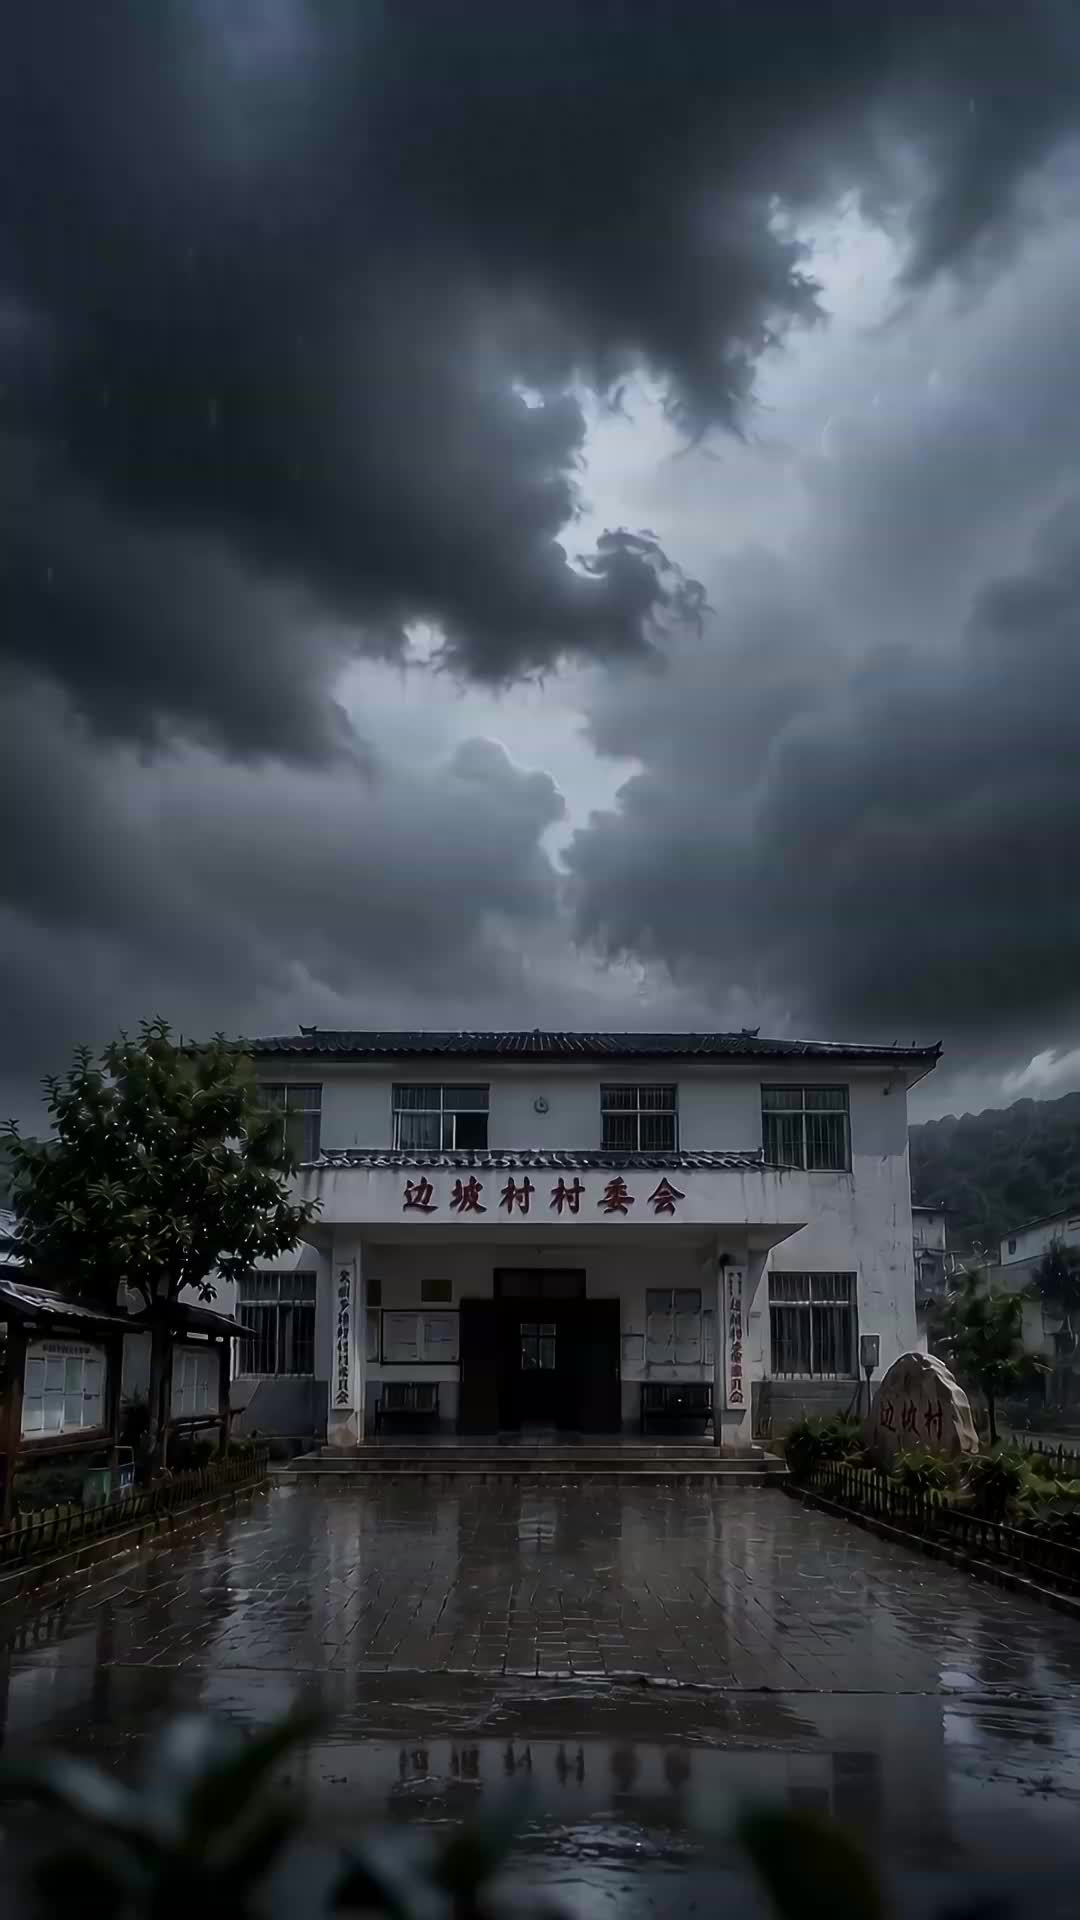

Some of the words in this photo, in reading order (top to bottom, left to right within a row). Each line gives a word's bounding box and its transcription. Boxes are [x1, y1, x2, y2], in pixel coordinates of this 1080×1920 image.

[402, 1175, 686, 1217] 边坡村村委会
